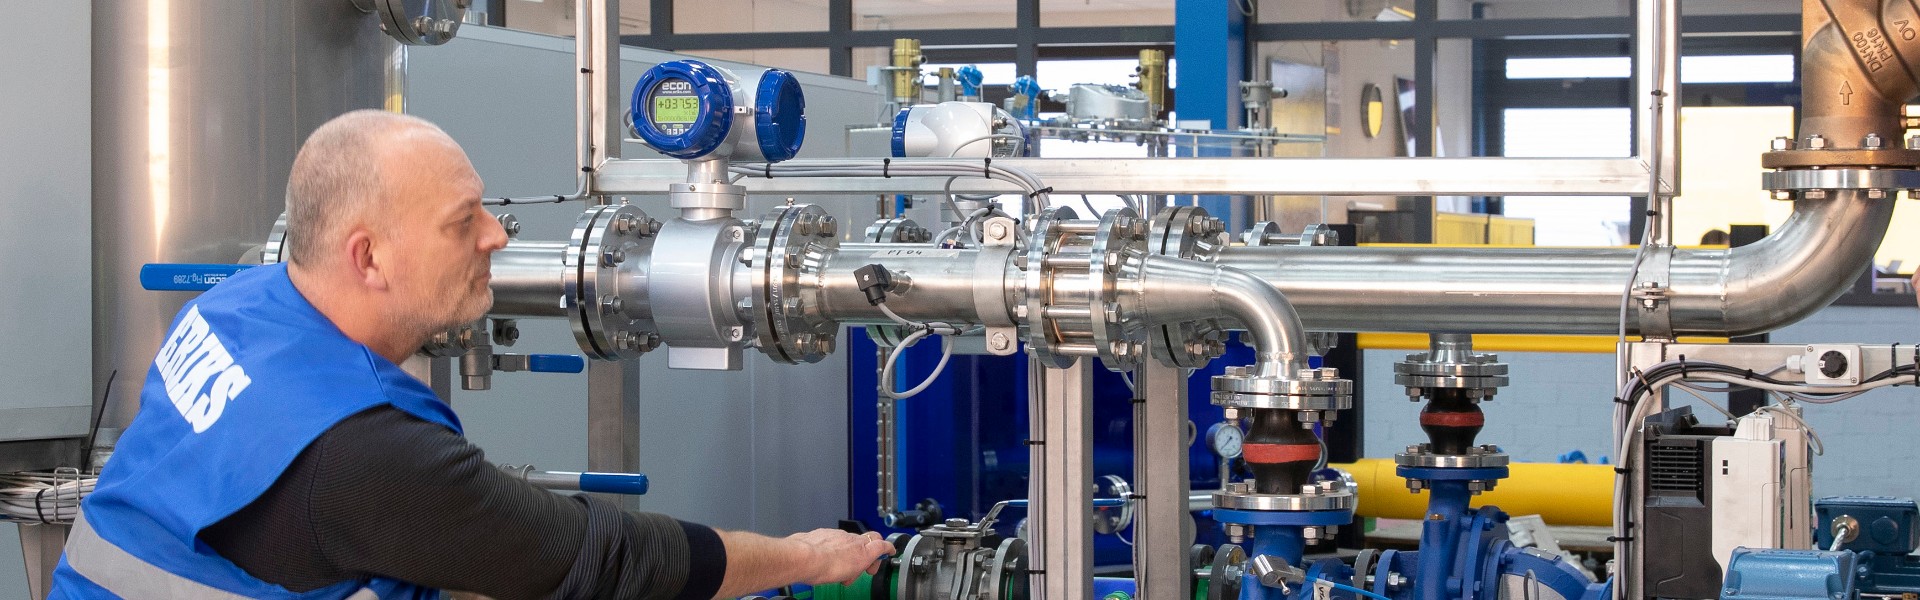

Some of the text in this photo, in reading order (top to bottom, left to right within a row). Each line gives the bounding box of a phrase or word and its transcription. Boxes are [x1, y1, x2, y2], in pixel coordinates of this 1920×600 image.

[1866, 27, 1893, 62] PN16
[1893, 19, 1916, 41] OV
[1853, 31, 1883, 73] DN100
[662, 81, 692, 90] econ
[155, 304, 252, 433] ERIKS
